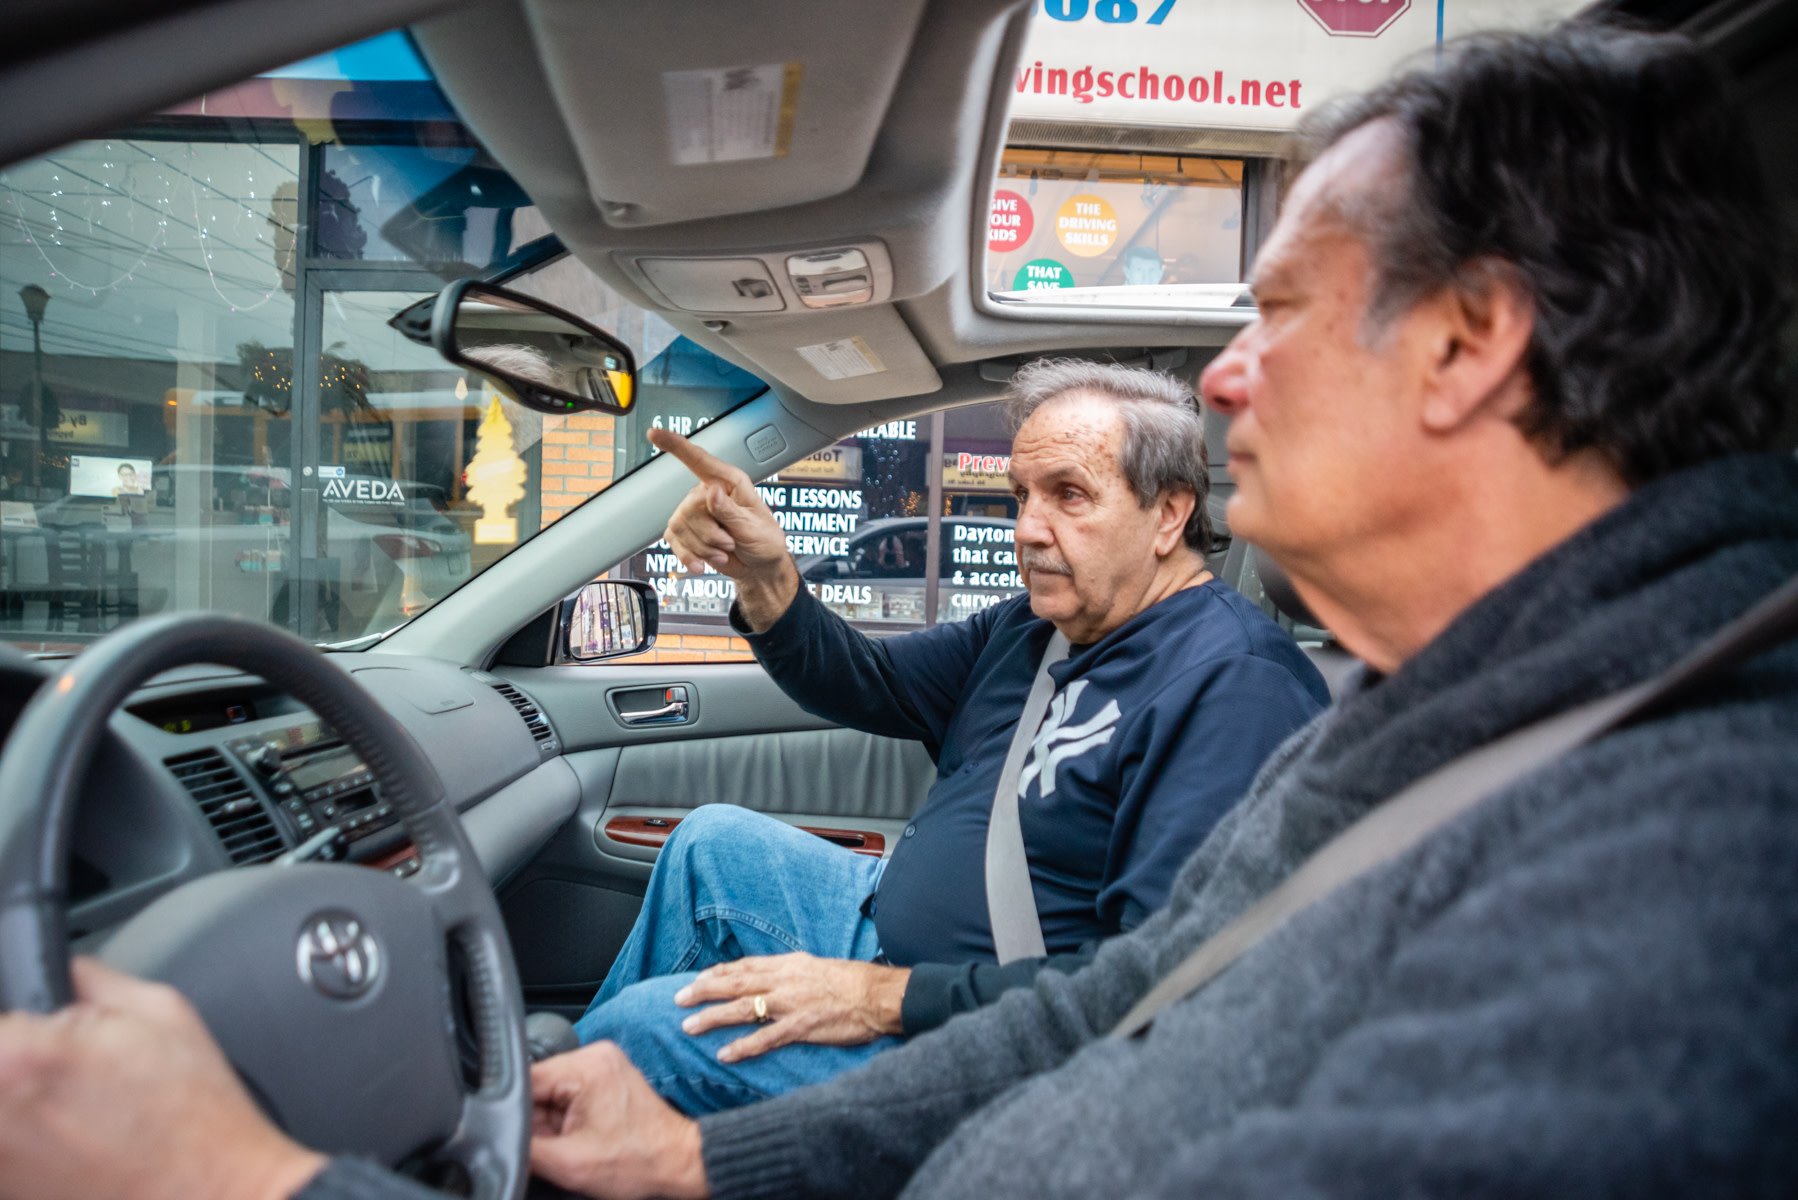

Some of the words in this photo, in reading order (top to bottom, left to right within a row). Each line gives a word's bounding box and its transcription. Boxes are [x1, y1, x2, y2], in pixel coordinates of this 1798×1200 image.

[1016, 60, 1302, 109] vingschool.net
[1075, 202, 1101, 215] THE
[991, 213, 1021, 226] OUR
[1059, 216, 1116, 232] DRIVING
[1066, 231, 1109, 246] SKILLS
[1027, 265, 1062, 279] THAT
[669, 415, 692, 436] HR
[958, 452, 1011, 473] Prev
[322, 478, 405, 501] AVEDA
[791, 488, 863, 510] LESSONS
[772, 511, 859, 533] OINTMENT
[785, 535, 850, 557] SERVICE
[952, 547, 989, 565] that
[648, 577, 678, 598] ASK
[952, 570, 965, 586] &
[821, 583, 872, 605] DEALS
